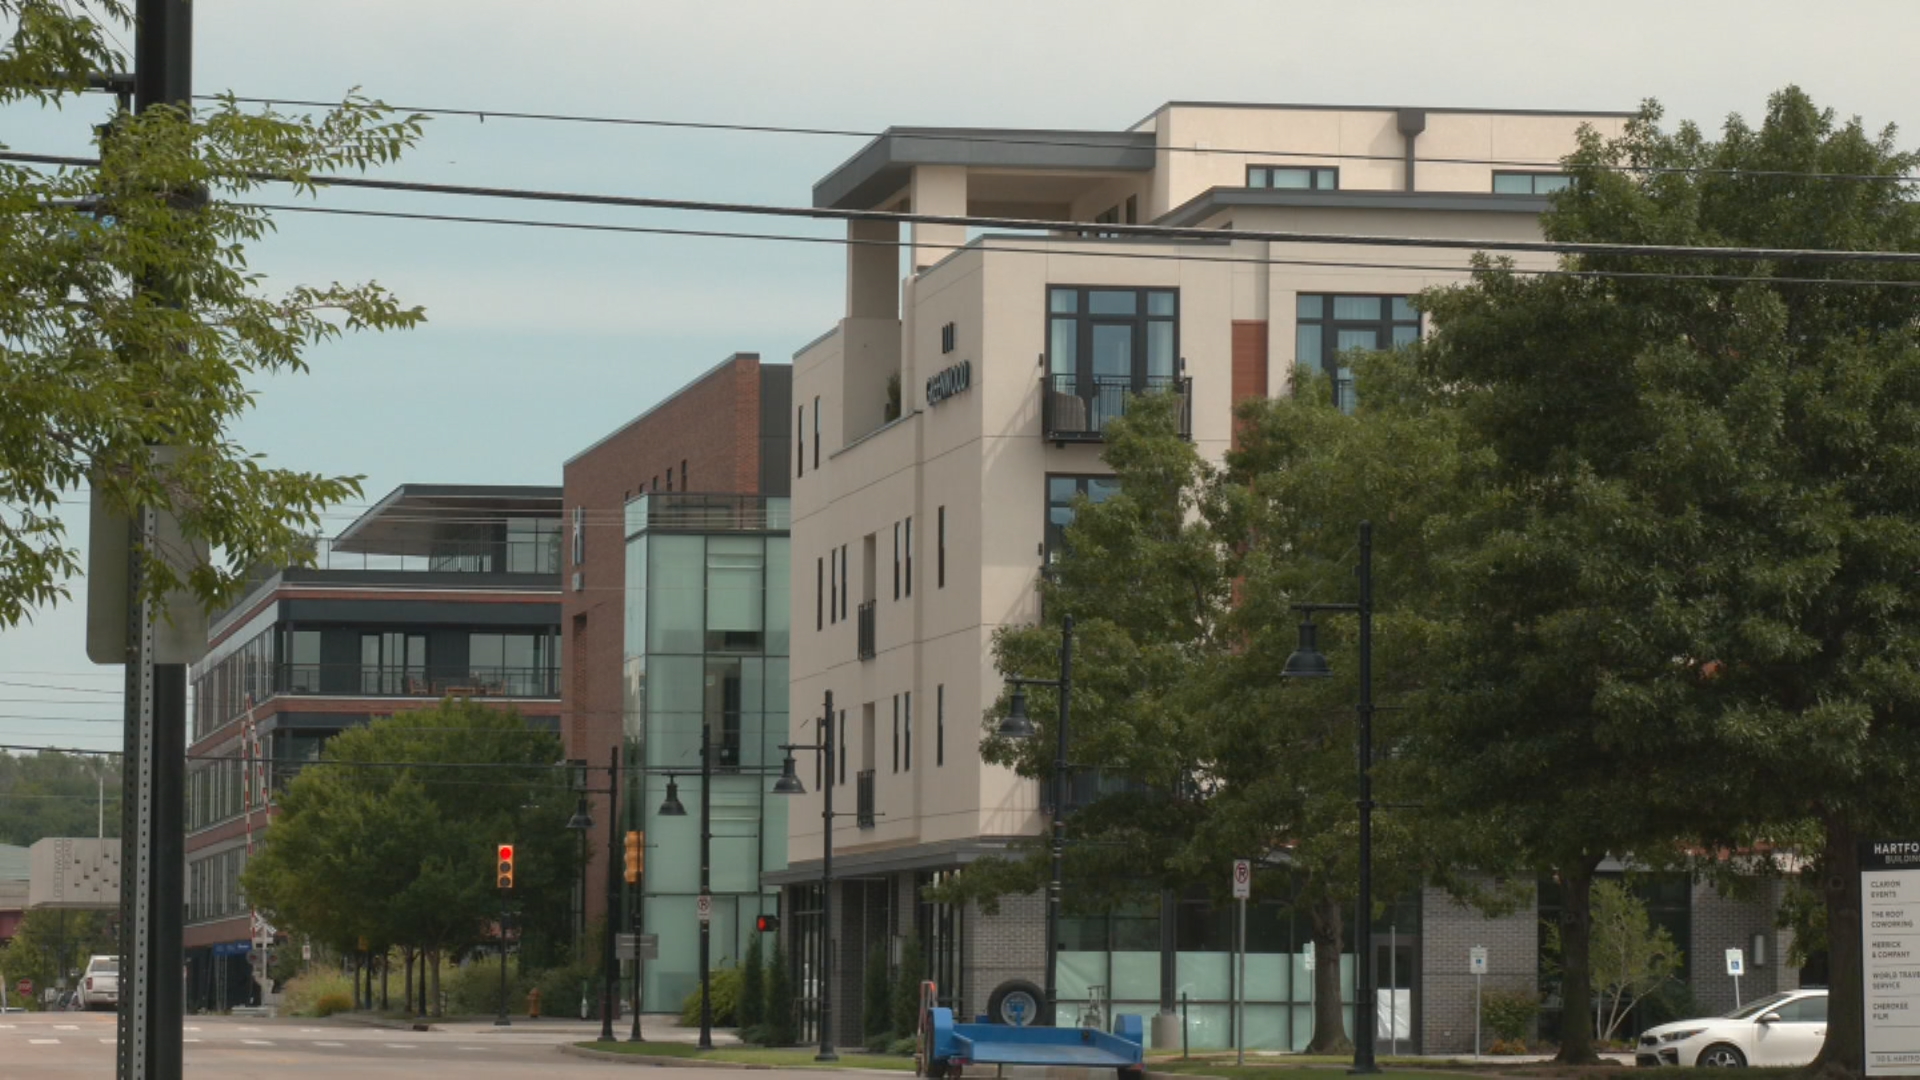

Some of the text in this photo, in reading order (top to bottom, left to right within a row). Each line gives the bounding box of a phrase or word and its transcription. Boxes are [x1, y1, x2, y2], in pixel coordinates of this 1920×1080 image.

[926, 359, 970, 406] GREENWOOD
[54, 839, 62, 898] GREENWOOD
[1873, 1002, 1908, 1010] CHEROKEE
